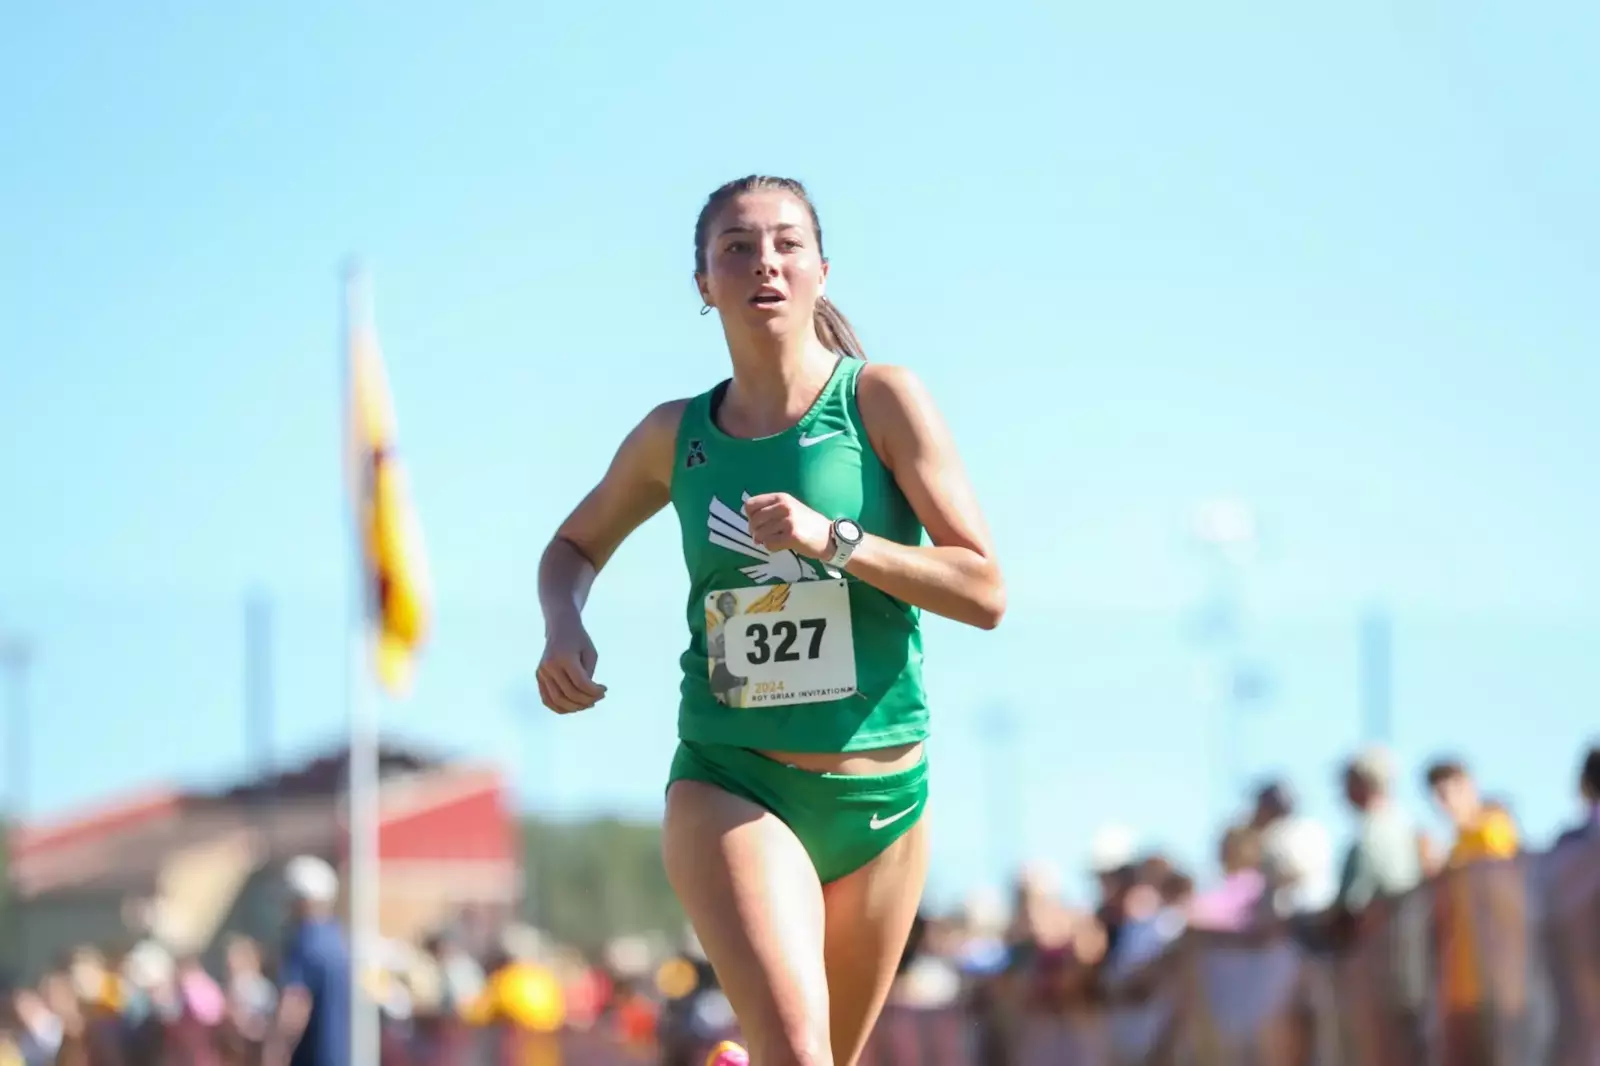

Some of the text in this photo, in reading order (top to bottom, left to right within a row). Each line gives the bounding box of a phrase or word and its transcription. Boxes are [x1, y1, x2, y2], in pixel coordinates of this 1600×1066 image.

[745, 618, 827, 665] 327
[754, 681, 784, 693] 2024
[799, 687, 854, 697] INVITATIONA
